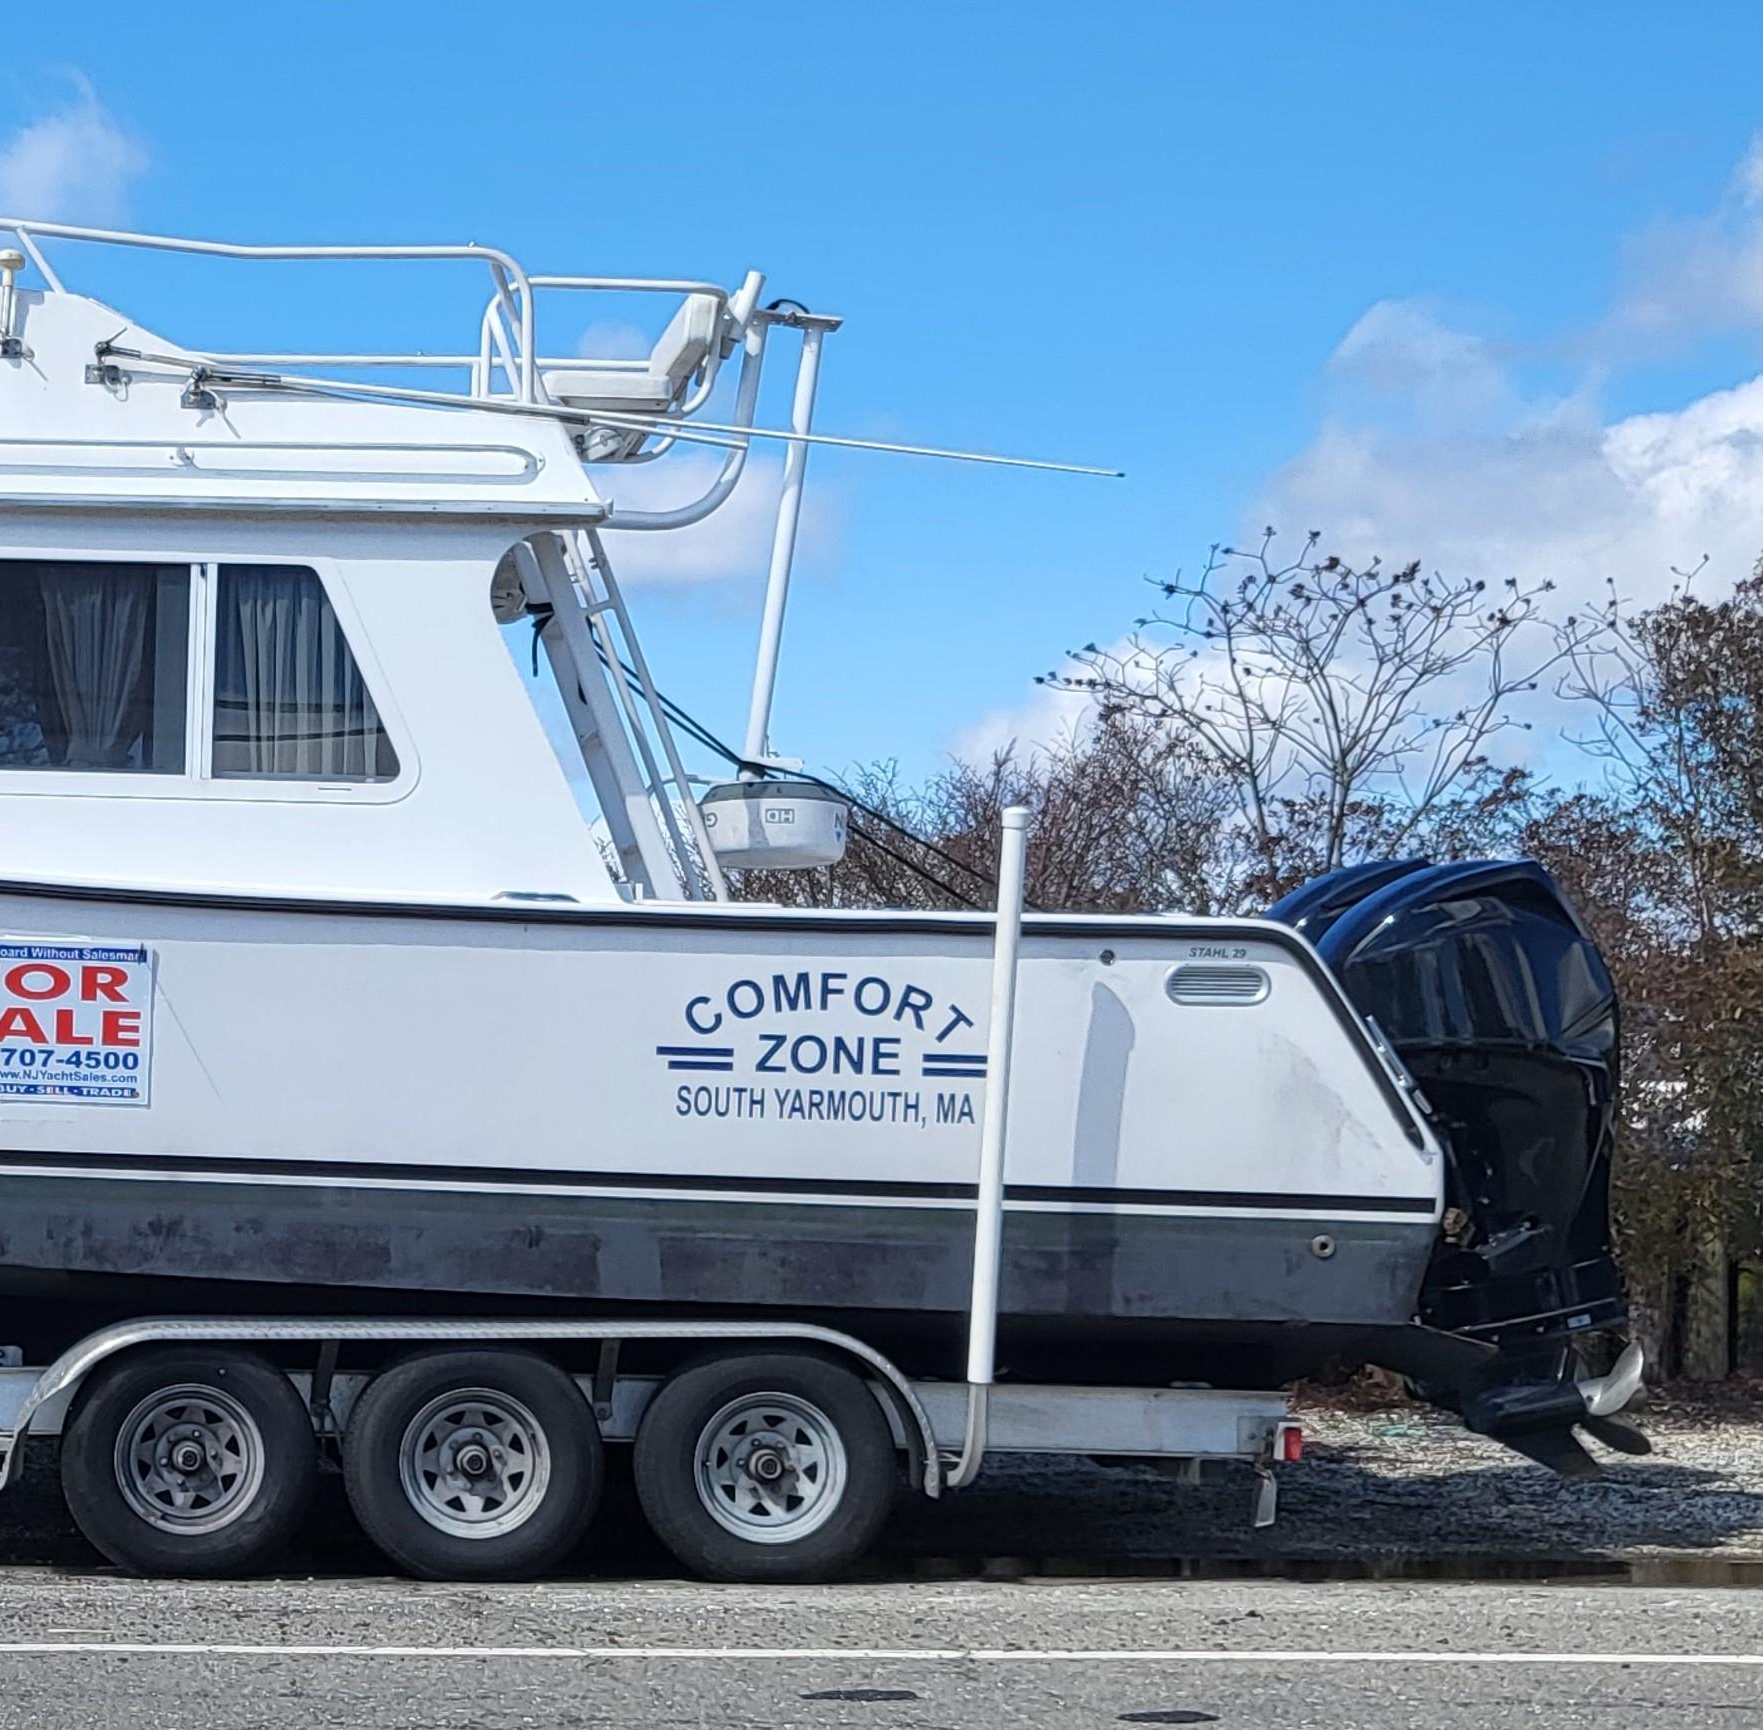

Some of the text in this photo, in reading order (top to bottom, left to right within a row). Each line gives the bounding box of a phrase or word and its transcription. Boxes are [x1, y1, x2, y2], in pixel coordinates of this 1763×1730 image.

[31, 946, 79, 959] Without
[1189, 947, 1229, 958] STAHL
[685, 972, 974, 1043] COMFORT
[0, 1048, 138, 1071] 707-4500
[755, 1034, 901, 1075] ZONE
[37, 1085, 69, 1094] SELL
[81, 1087, 132, 1097] TRADE
[676, 1085, 975, 1128] SOUTH YARMOUTH, MA
